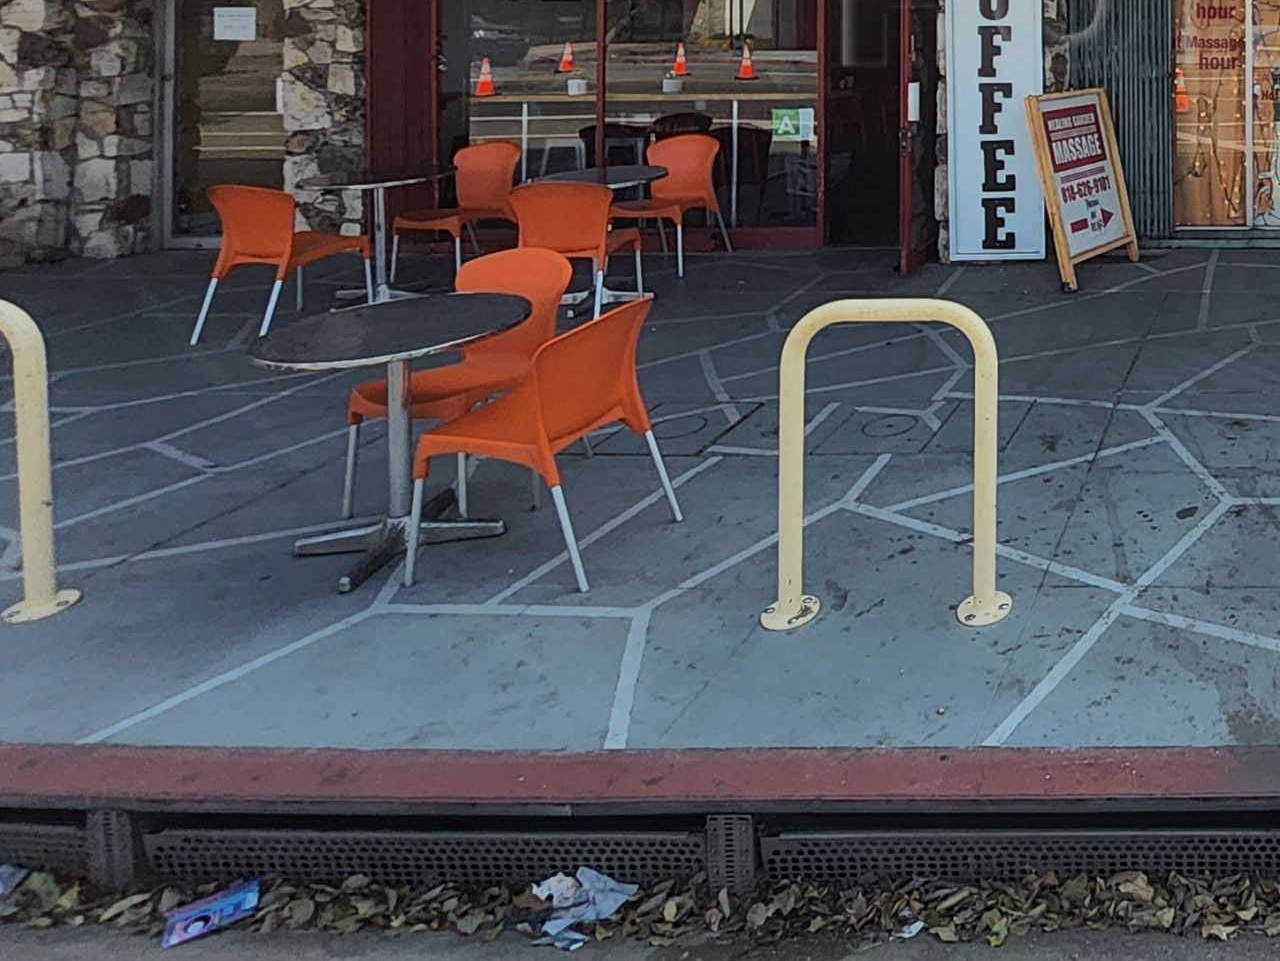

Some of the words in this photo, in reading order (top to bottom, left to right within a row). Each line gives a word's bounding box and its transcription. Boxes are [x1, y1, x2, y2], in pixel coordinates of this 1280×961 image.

[1196, 3, 1236, 19] hour
[1199, 53, 1238, 70] hour
[777, 115, 796, 134] A
[1052, 133, 1103, 165] MASSAGE
